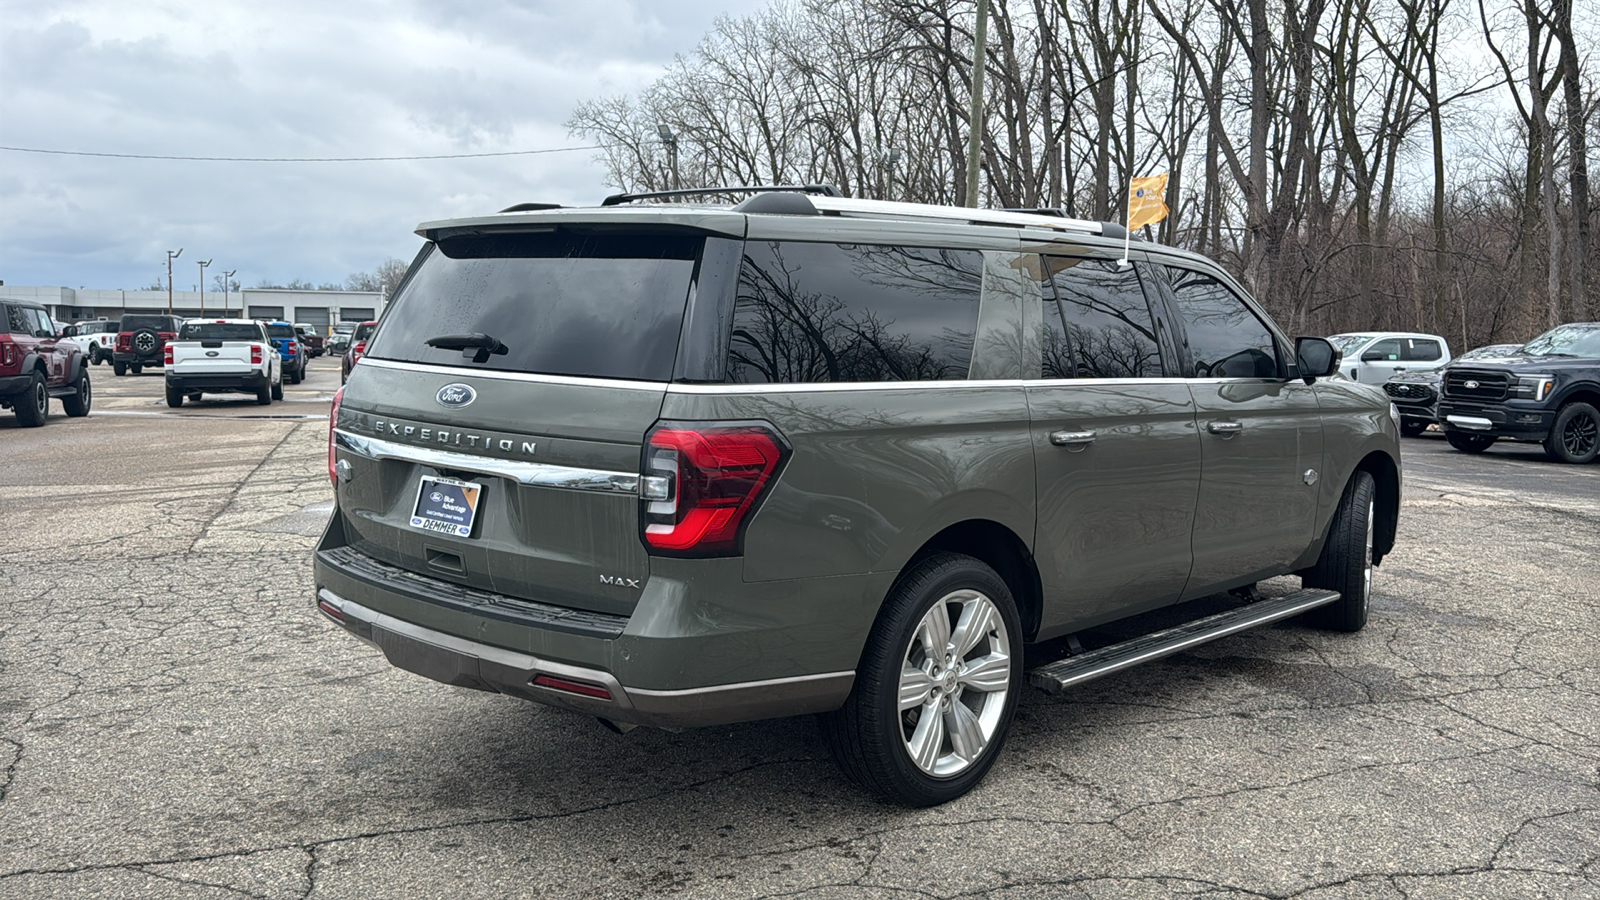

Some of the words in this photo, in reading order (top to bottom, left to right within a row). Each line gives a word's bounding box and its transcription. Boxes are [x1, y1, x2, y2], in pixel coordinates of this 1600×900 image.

[442, 387, 466, 402] Ford
[375, 421, 537, 454] EXPEDITION
[443, 495, 455, 503] Blue
[442, 502, 466, 514] Advantage
[422, 519, 458, 534] DEMMER
[600, 574, 640, 589] MAX
